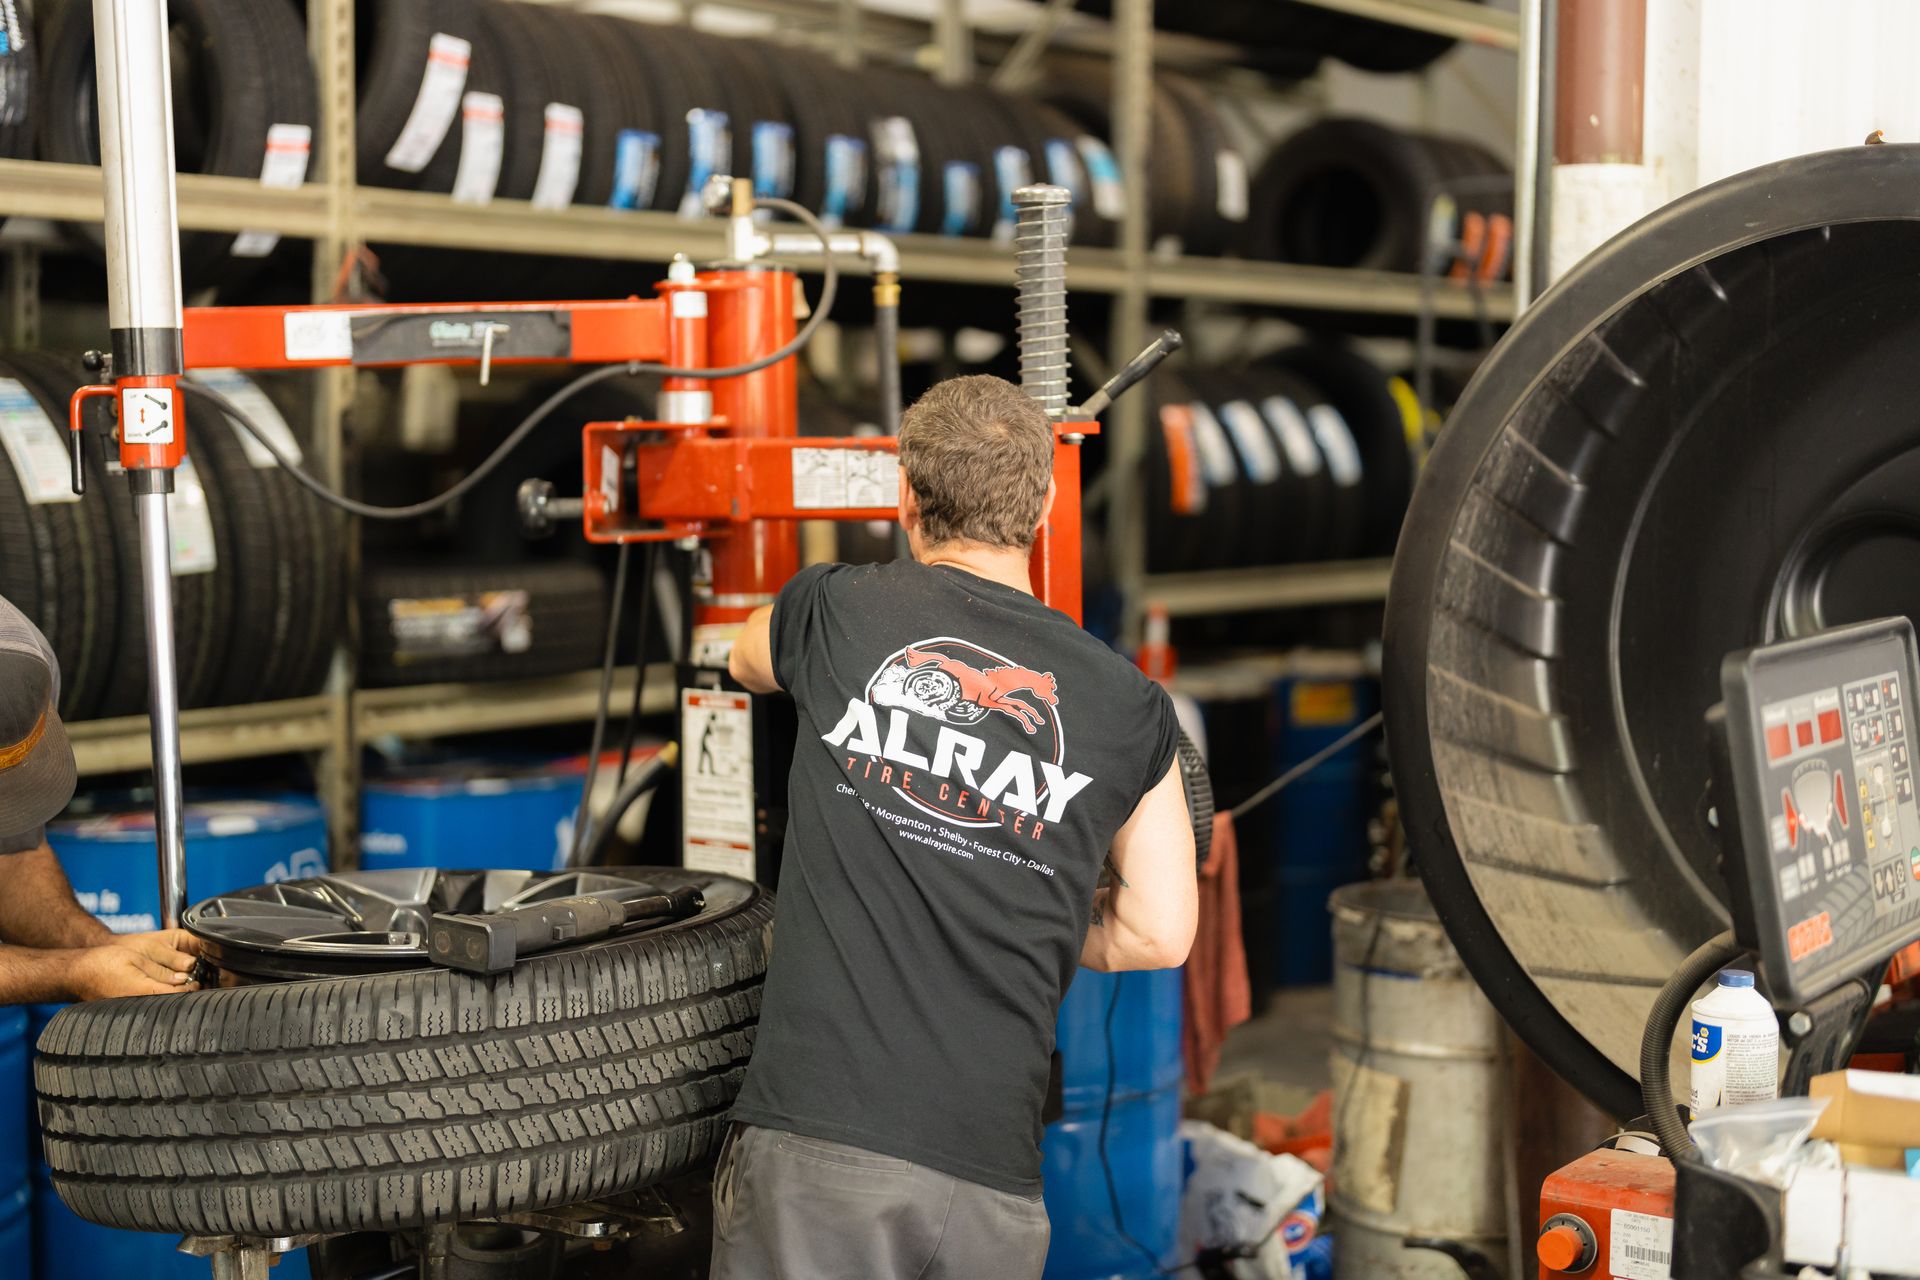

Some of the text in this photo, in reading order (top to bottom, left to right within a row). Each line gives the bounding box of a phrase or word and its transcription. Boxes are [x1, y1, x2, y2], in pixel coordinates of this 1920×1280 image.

[821, 697, 1094, 824] ALRAY
[847, 757, 1044, 841] TIRE CENTER
[876, 807, 931, 833] Morganton
[938, 827, 968, 847] Shelby
[973, 841, 1001, 859] Forest
[1002, 851, 1022, 866] City
[1027, 859, 1054, 876] Dallas
[899, 829, 974, 860] www.alraytire.com
